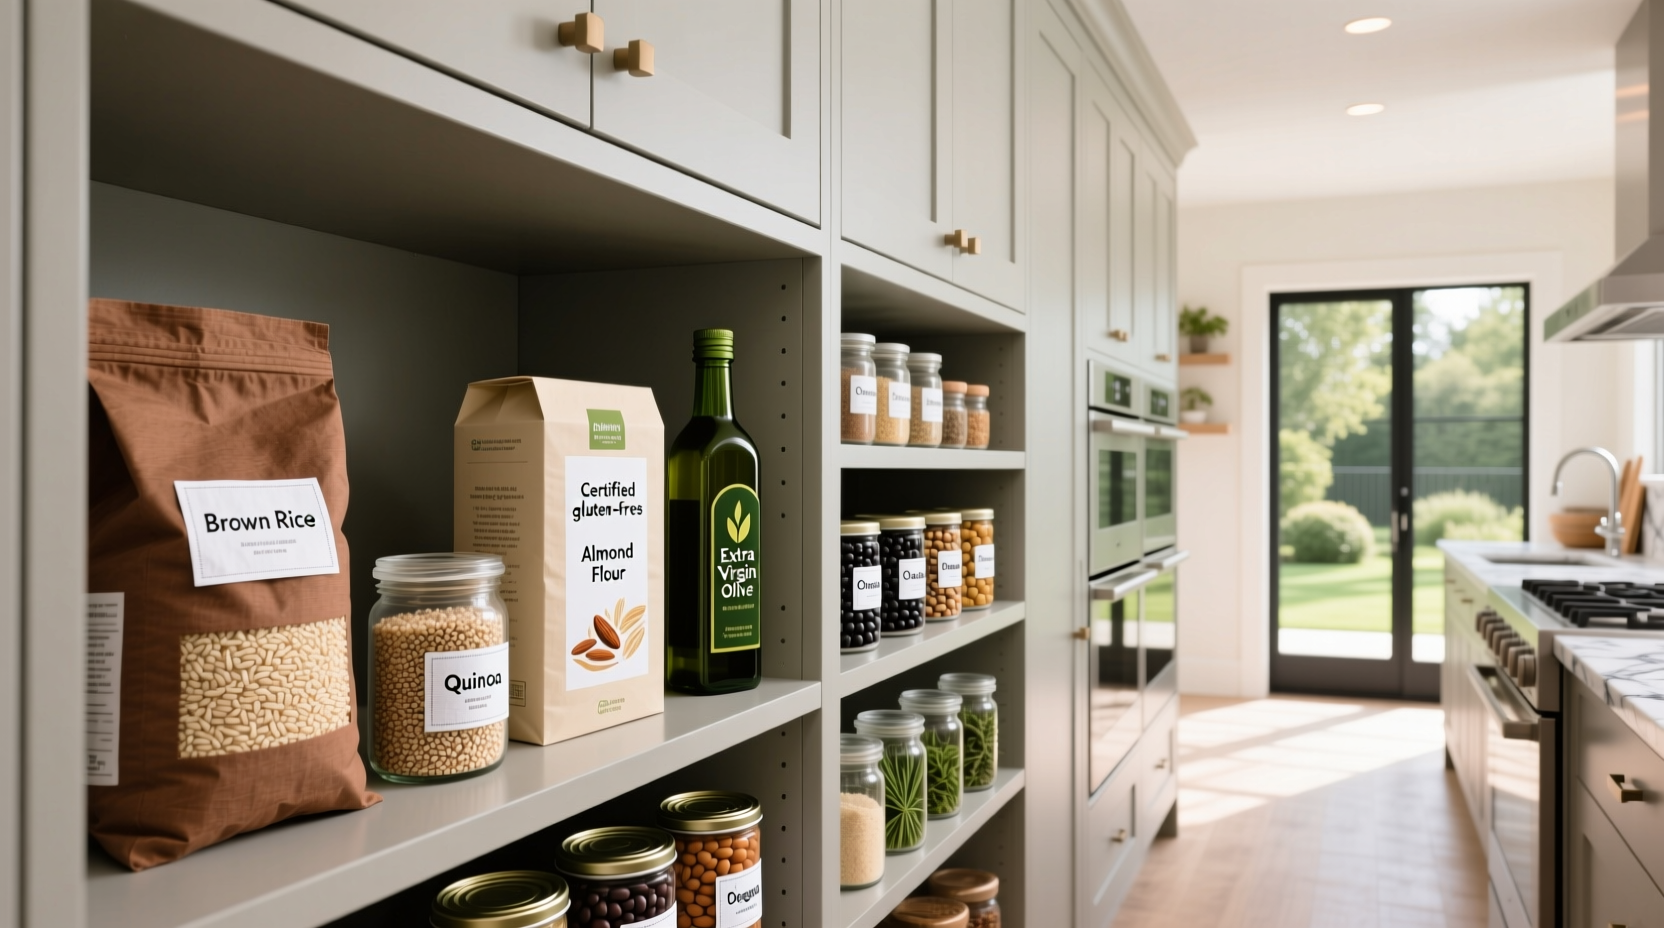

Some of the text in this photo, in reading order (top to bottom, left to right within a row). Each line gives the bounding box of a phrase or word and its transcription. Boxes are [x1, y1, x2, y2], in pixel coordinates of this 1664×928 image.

[581, 481, 635, 497] Certified
[204, 510, 316, 533] Brown Rice
[581, 542, 634, 562] Almond
[720, 547, 755, 563] Extra
[592, 565, 626, 582] Flour
[717, 564, 757, 584] Virgin
[444, 672, 502, 695] Quinoa
